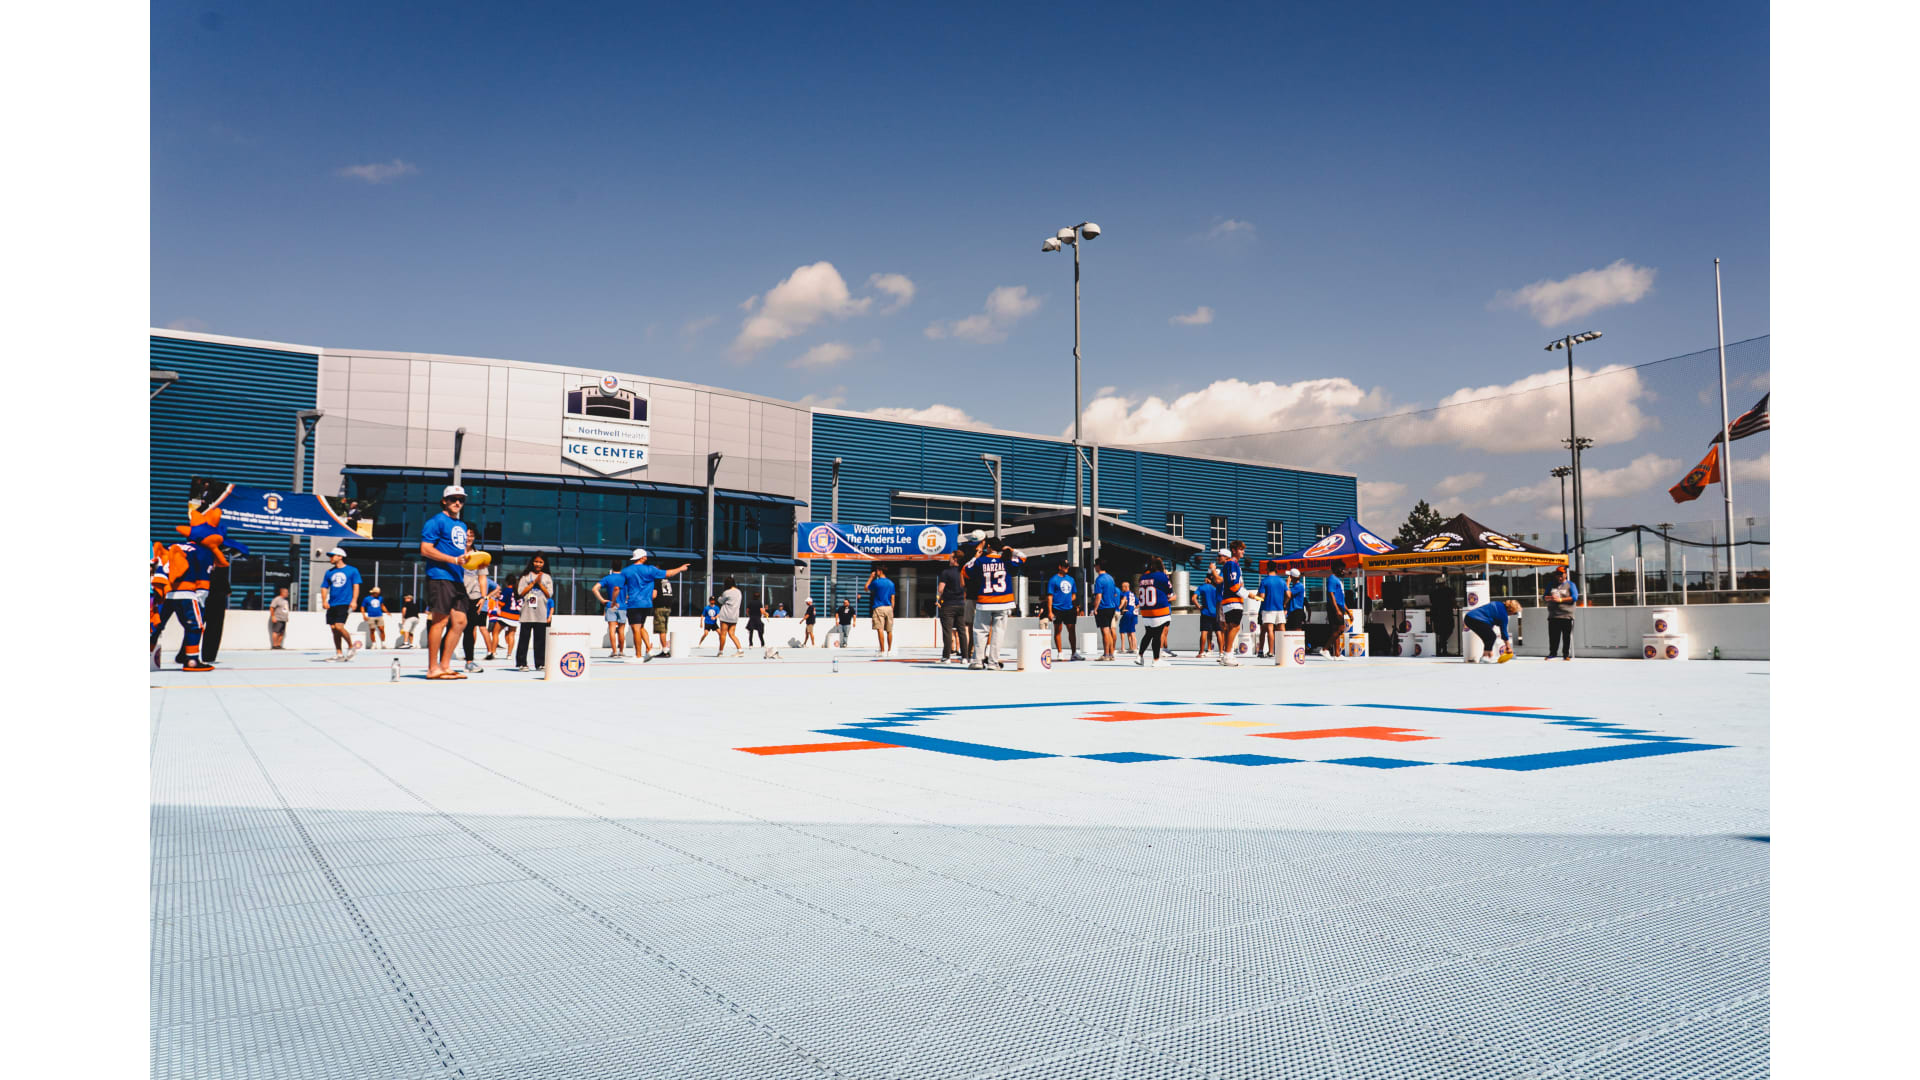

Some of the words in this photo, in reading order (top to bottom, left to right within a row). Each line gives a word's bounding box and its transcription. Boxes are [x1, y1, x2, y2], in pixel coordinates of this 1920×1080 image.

[578, 426, 620, 437] Northwell
[568, 444, 588, 454] ICE
[594, 446, 644, 460] CENTER
[854, 525, 894, 534] Welcome
[895, 526, 905, 534] to
[845, 534, 862, 543] The
[864, 534, 895, 544] Anders
[896, 535, 912, 544] Lee
[884, 544, 903, 554] Jam
[982, 562, 1005, 572] BARZAL
[983, 570, 1007, 594] 13
[1139, 586, 1157, 607] 30
